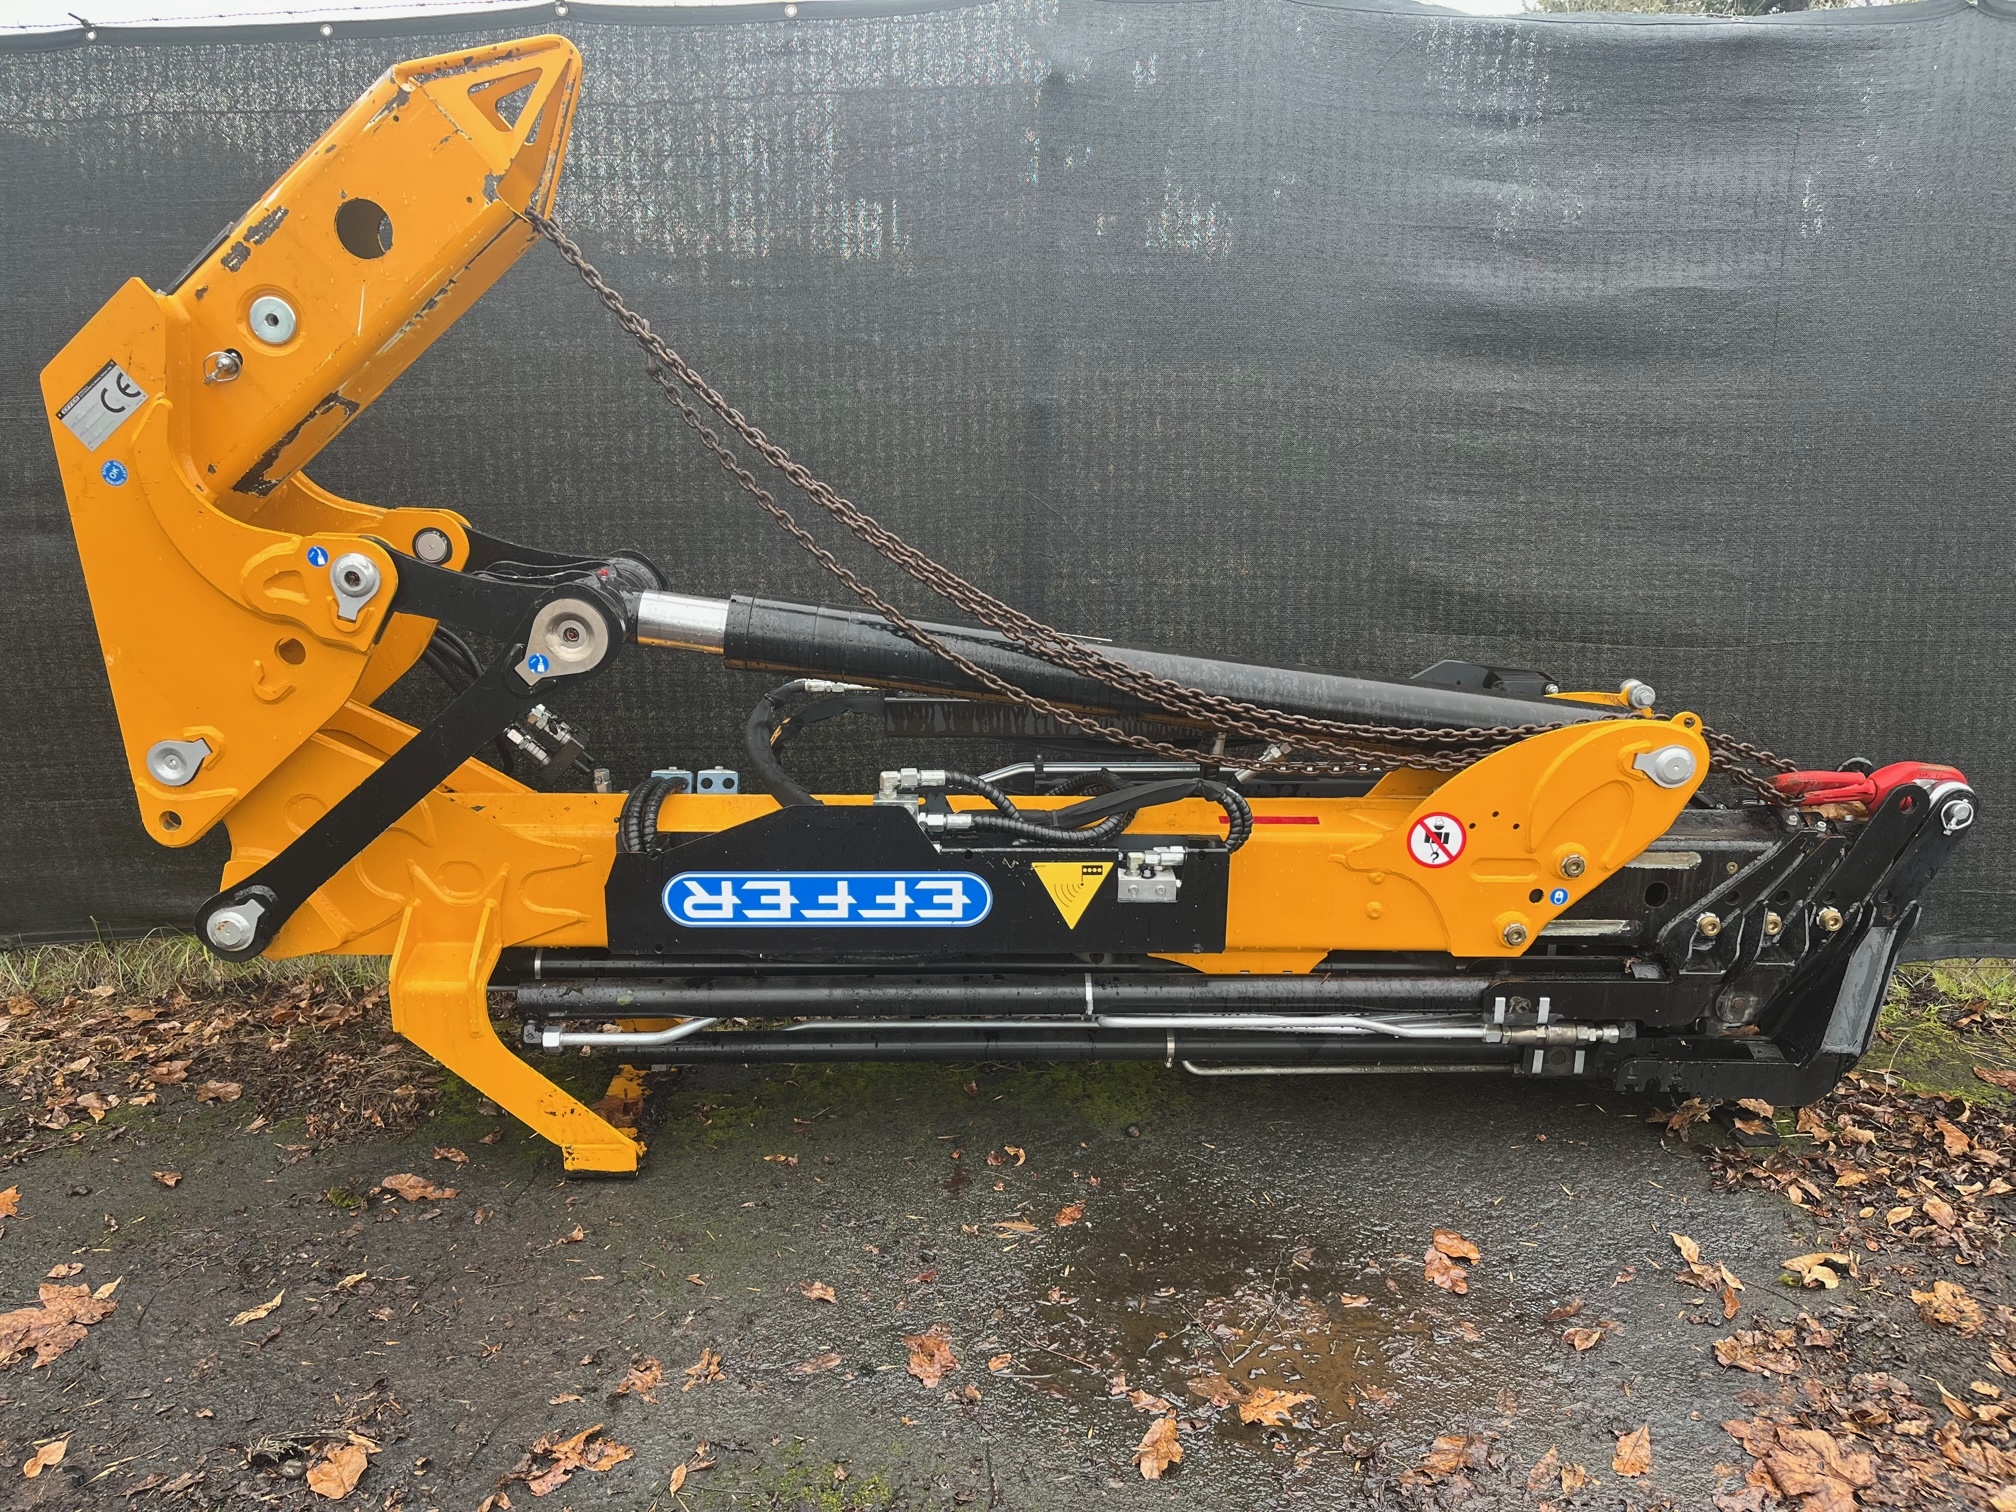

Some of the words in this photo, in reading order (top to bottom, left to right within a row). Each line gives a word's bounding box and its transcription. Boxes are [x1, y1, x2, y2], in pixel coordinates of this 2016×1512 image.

[101, 372, 141, 413] CE
[109, 467, 119, 479] OK
[683, 880, 971, 919] EFFER
